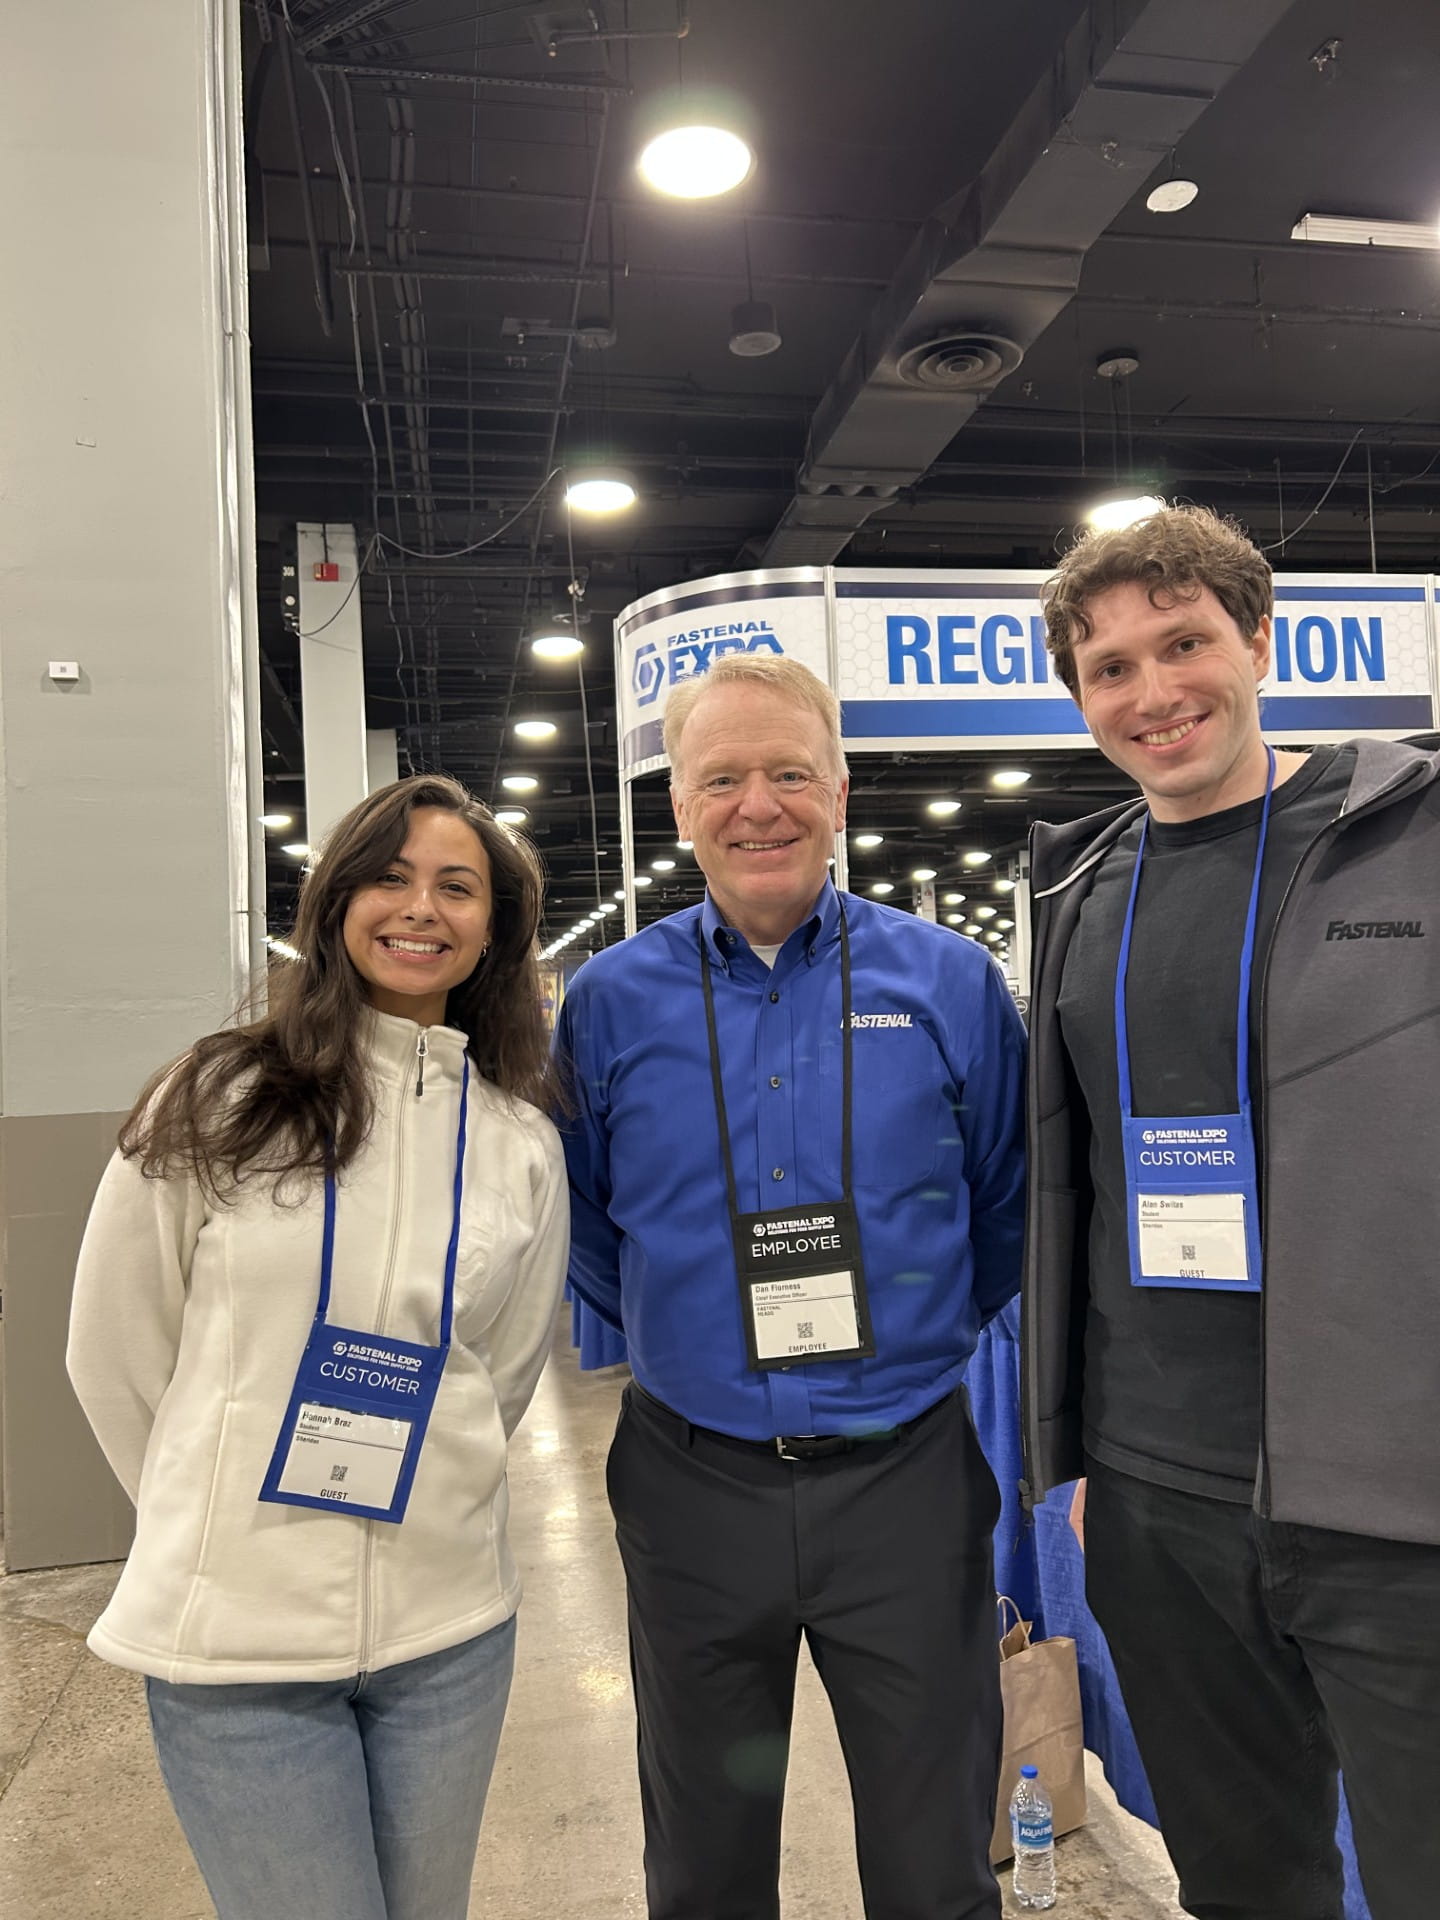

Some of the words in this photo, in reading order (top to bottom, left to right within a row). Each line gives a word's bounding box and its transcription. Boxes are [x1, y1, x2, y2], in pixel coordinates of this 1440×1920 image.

[667, 620, 773, 647] FASTENAL
[1325, 920, 1425, 941] FASTENAL
[1156, 1130, 1201, 1138] FASTENAL
[1202, 1129, 1228, 1138] EXPO
[1139, 1151, 1236, 1166] CUSTOMER
[767, 1218, 811, 1230] FASTENAL
[812, 1216, 835, 1225] EXPO
[752, 1235, 842, 1258] EMPLOYEE
[1180, 1269, 1205, 1278] GUEST
[755, 1285, 768, 1293] Dan
[788, 1343, 827, 1353] EMPLOYEE
[348, 1343, 396, 1363] FASTENAL
[397, 1354, 423, 1368] EXPO
[320, 1361, 420, 1396] CUSTOMER
[302, 1410, 332, 1424] Hannah
[320, 1488, 349, 1501] GUEST
